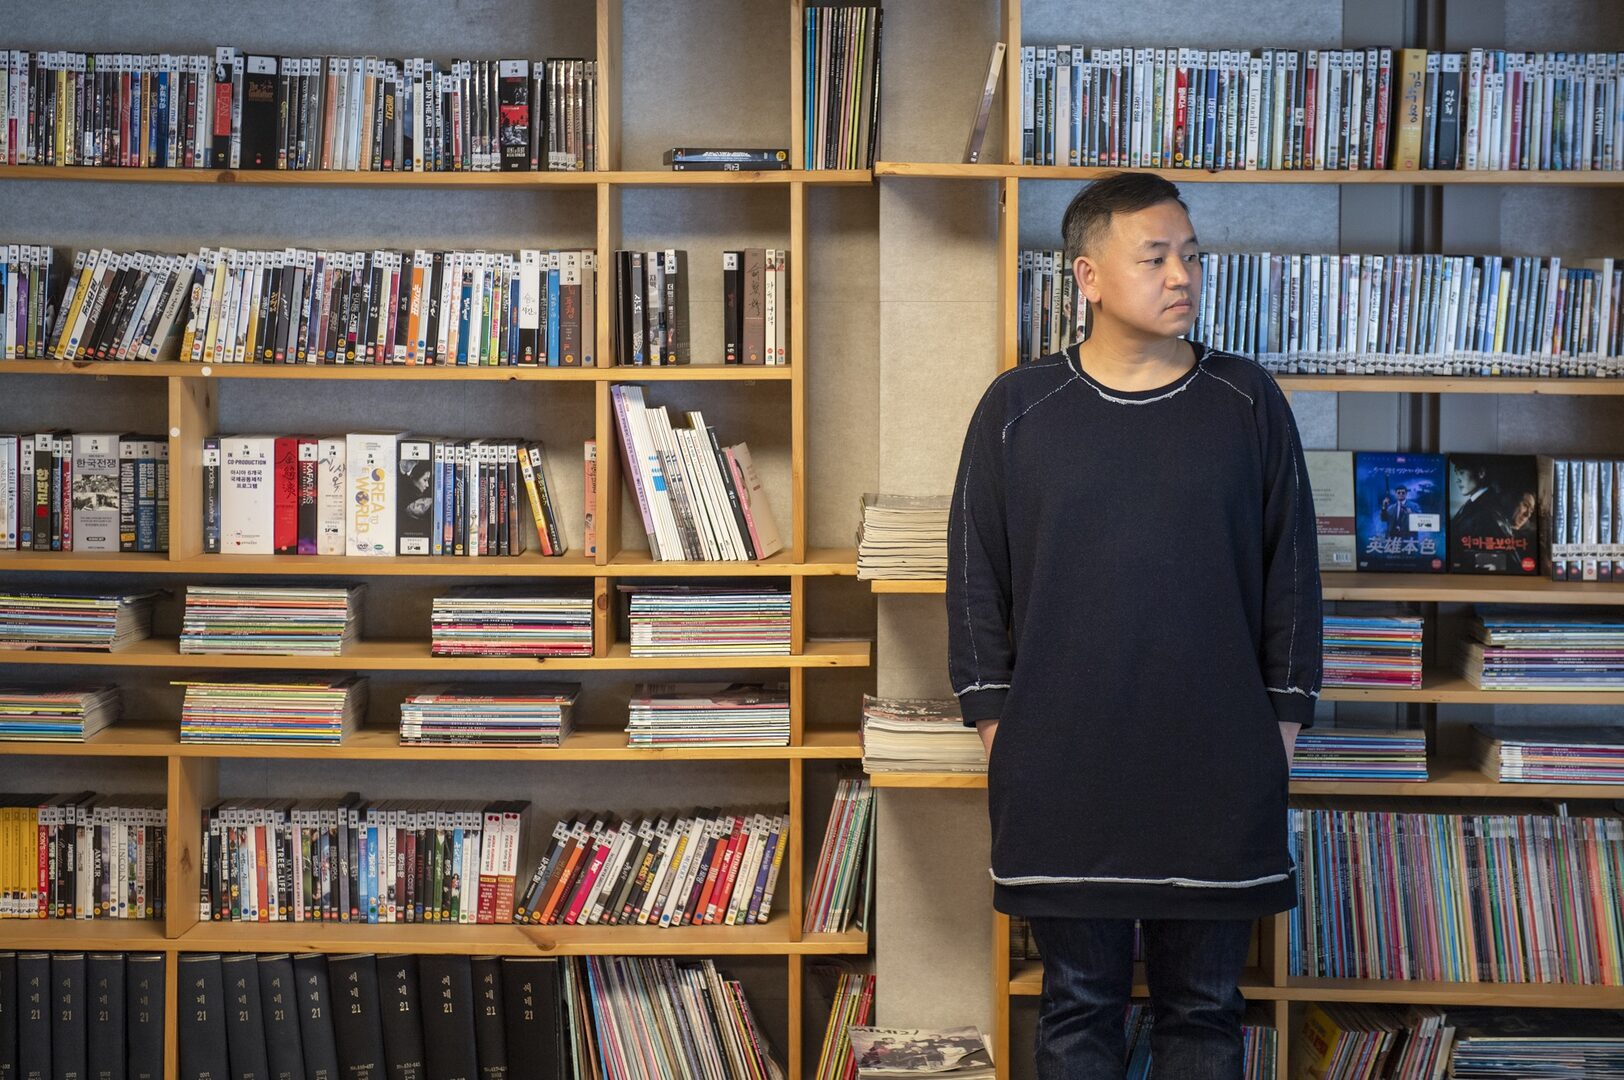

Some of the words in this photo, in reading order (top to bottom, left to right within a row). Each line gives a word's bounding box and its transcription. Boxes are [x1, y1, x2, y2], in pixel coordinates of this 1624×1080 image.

[220, 83, 230, 116] CLEAN
[1595, 107, 1604, 136] KEVIN
[77, 458, 117, 469] 한국전쟁
[121, 463, 135, 493] WORLD
[139, 464, 147, 498] COLLECTION
[121, 494, 135, 513] WAR
[355, 477, 370, 534] WORLD
[1366, 536, 1436, 554] 英雄本色
[119, 843, 127, 882] LINCOLN
[277, 848, 285, 869] TREE
[590, 859, 603, 874] her
[278, 876, 286, 892] LIFE
